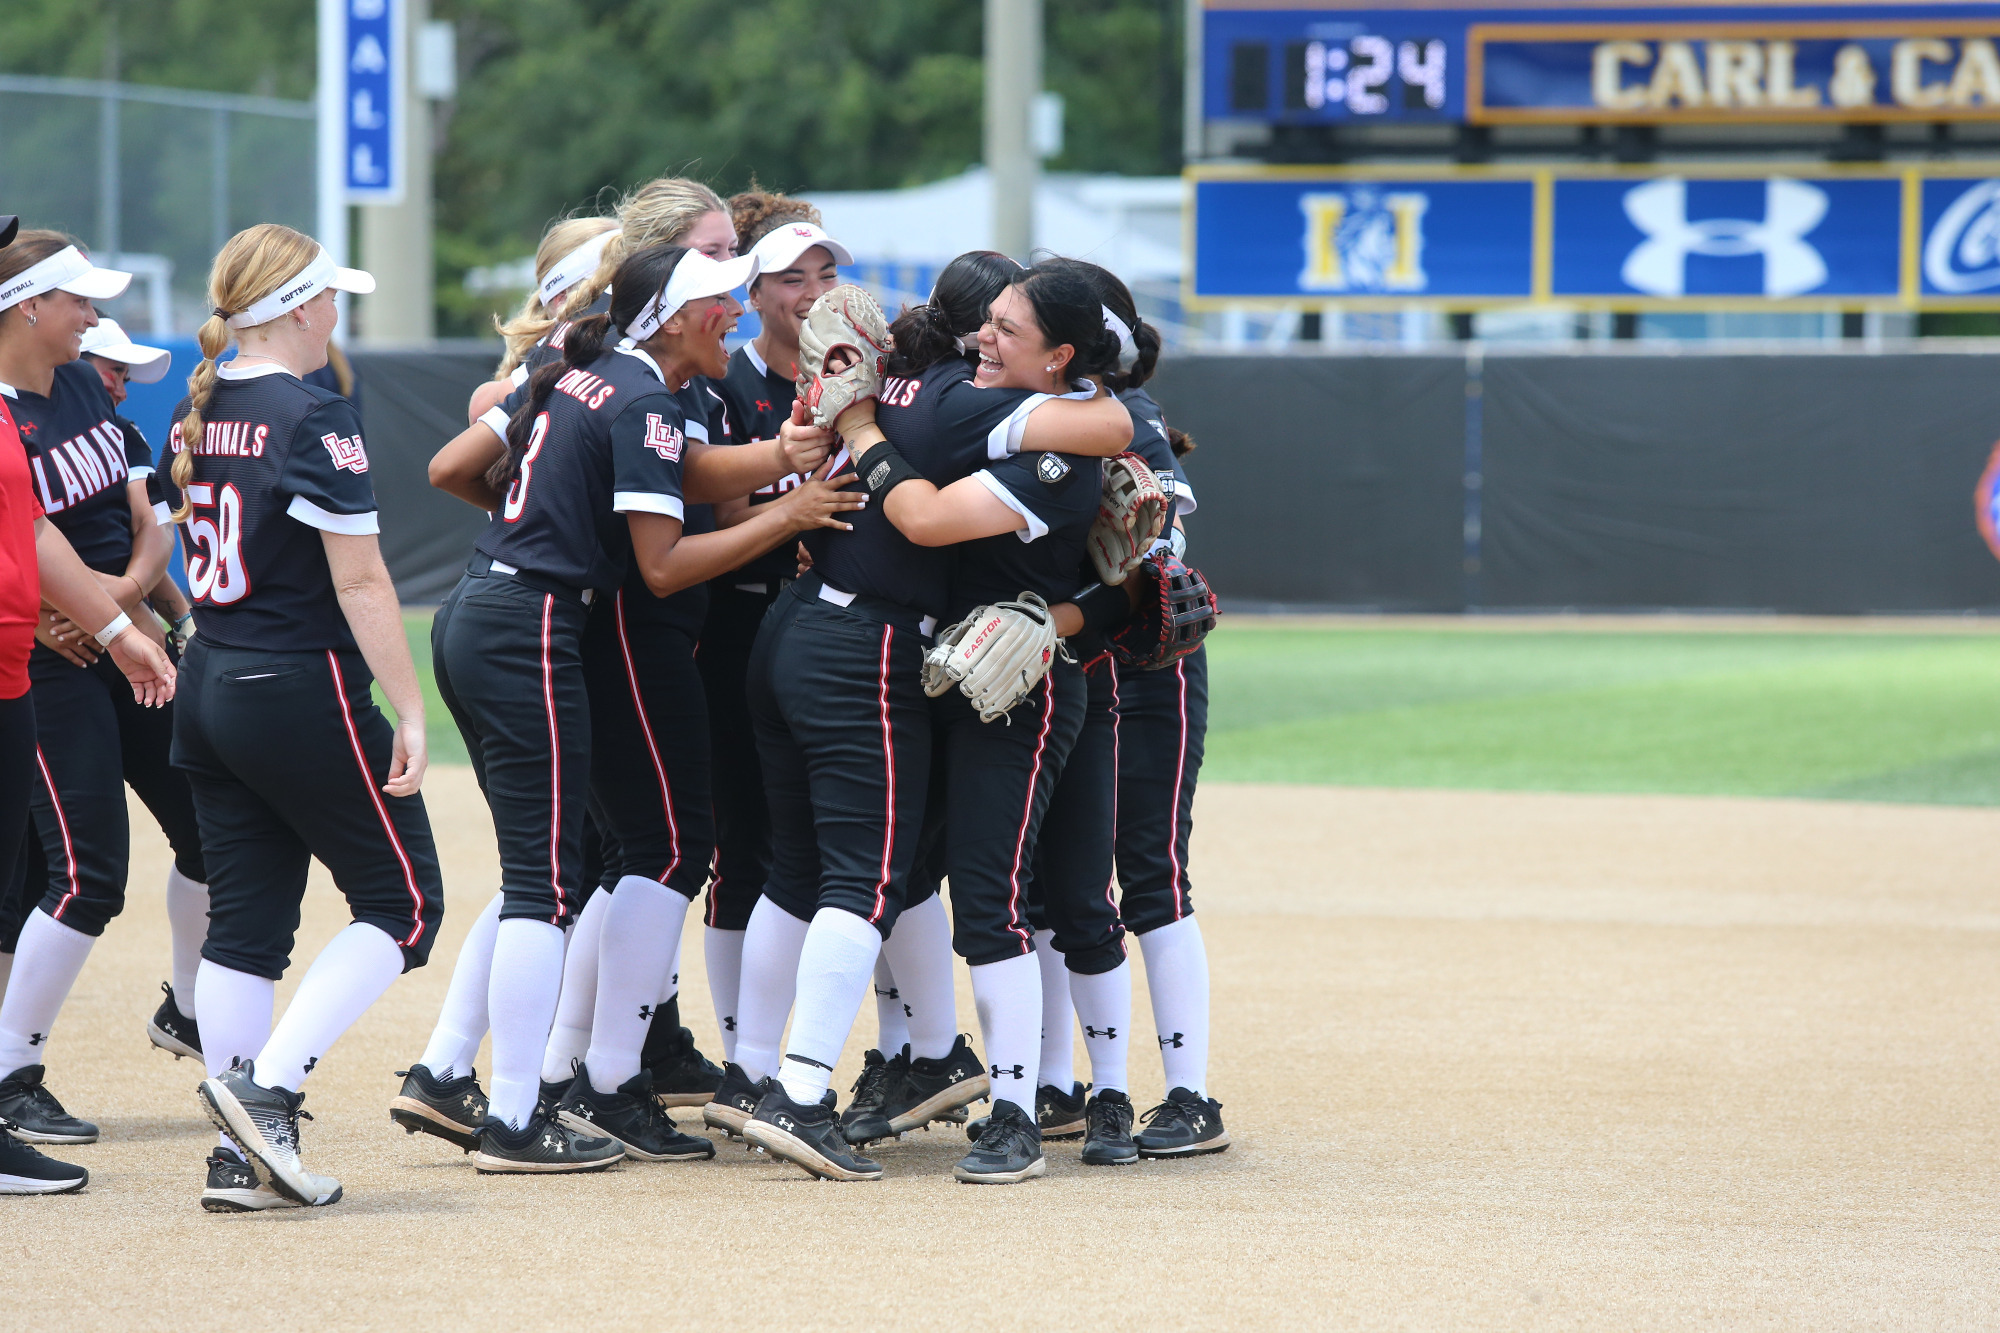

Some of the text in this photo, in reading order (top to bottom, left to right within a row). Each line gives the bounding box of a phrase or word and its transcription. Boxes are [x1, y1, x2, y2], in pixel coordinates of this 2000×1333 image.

[1304, 35, 1447, 115] 1:24
[1591, 39, 1820, 109] CARL
[0, 279, 34, 301] SOFTBALL
[280, 279, 314, 304] SOFTBALL
[1040, 458, 1061, 479] 60
[183, 481, 251, 606] 59
[963, 616, 1002, 660] EASTON
